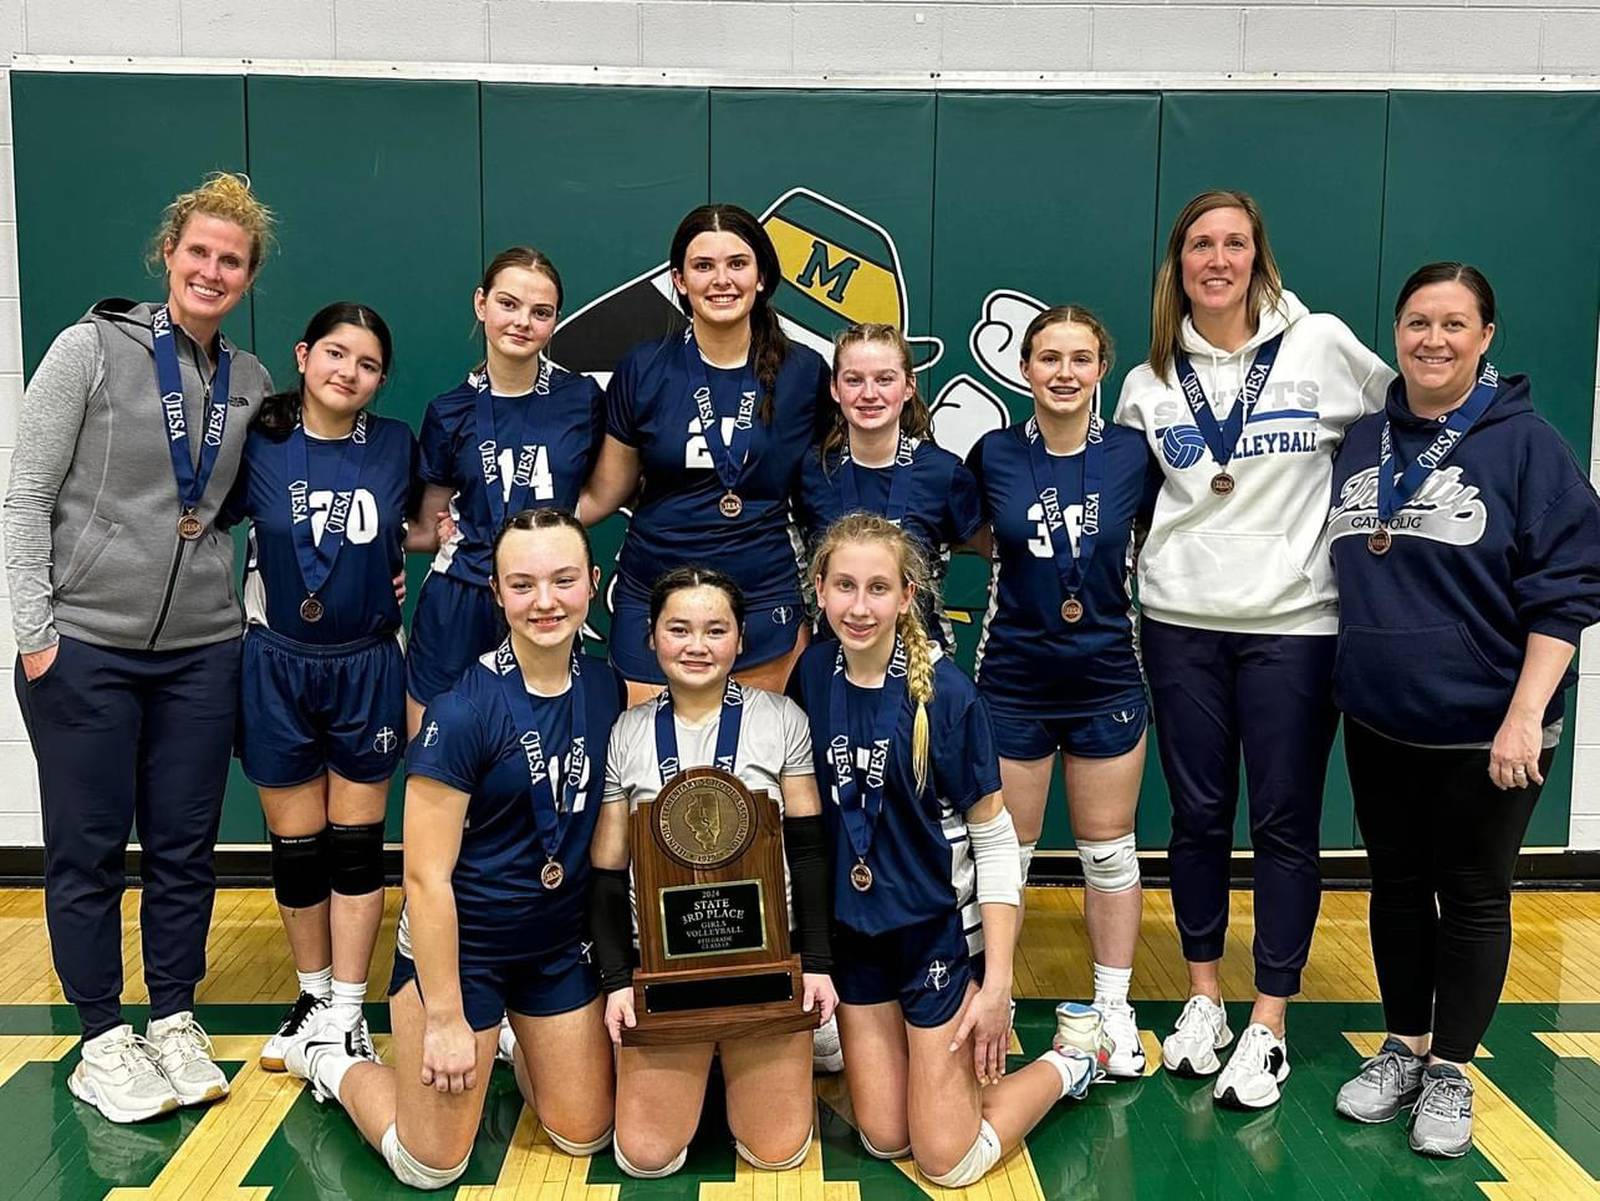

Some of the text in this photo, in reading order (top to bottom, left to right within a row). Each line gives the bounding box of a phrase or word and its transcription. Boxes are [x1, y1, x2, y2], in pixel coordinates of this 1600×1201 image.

[796, 239, 861, 304] M
[1186, 380, 1205, 413] IESA
[1247, 364, 1270, 403] IESA
[164, 401, 187, 441] IESA
[207, 403, 226, 440] IESA
[697, 399, 715, 430] IESA
[737, 390, 756, 423] IESA
[1233, 431, 1317, 459] LLEYBALL
[1426, 428, 1462, 463] IESA
[480, 450, 498, 485] IESA
[498, 445, 554, 502] 14
[518, 445, 537, 481] IESA
[291, 488, 308, 525] IESA
[331, 491, 352, 528] IESA
[1044, 497, 1064, 532] IESA
[1086, 493, 1099, 526] IESA
[525, 742, 546, 785] IESA
[571, 737, 584, 776] IESA
[834, 747, 852, 787] IESA
[870, 738, 890, 777] IESA
[682, 909, 745, 925] 3RD PLACE
[694, 898, 730, 911] STATE
[686, 926, 744, 938] VOLLEYBALL
[701, 920, 727, 929] GIRLS
